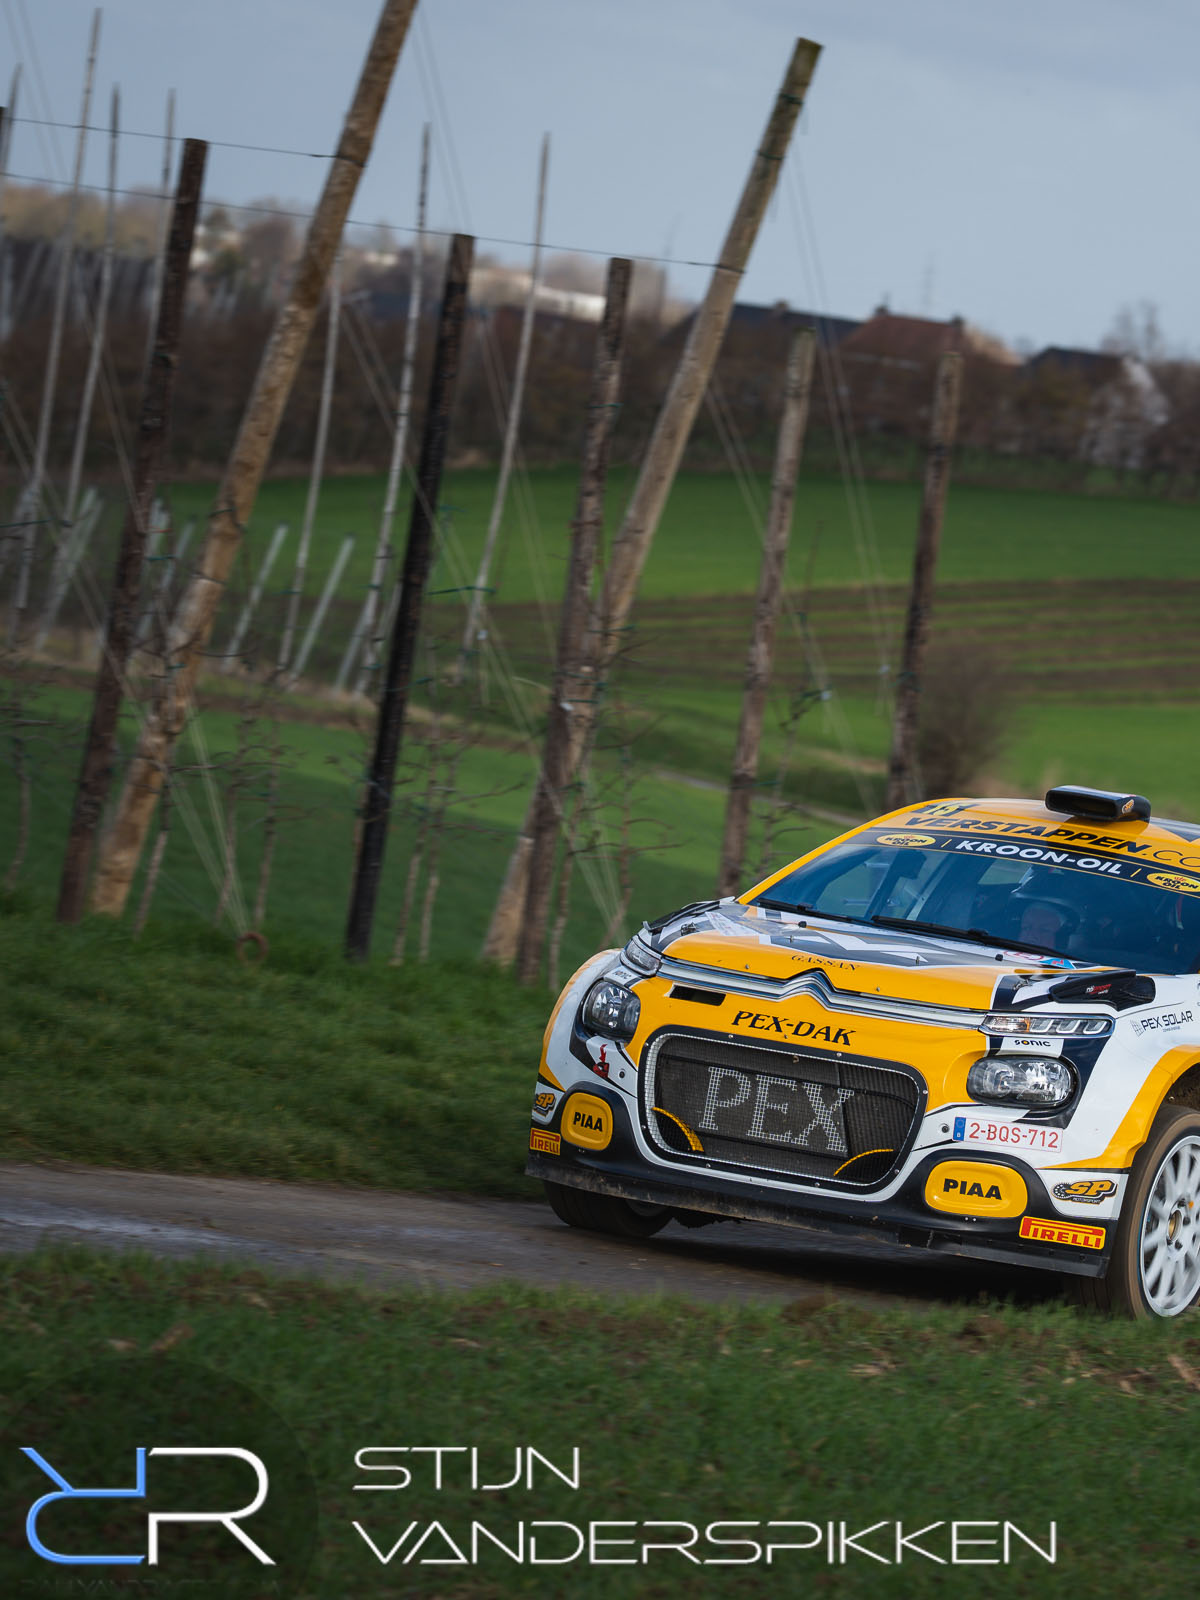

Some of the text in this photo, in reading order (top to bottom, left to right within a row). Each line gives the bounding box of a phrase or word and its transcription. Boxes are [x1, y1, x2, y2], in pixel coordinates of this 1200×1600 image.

[955, 840, 1122, 875] KROON-OIL
[731, 1011, 856, 1046] PEX-DAK
[1140, 1010, 1194, 1031] PEX SOLAR
[573, 1111, 603, 1132] PIAA
[699, 1066, 854, 1153] PEX
[531, 1129, 561, 1155] PIRELLI
[969, 1123, 1059, 1148] 2-BQS-712
[943, 1178, 1002, 1200] PIAA
[1065, 1180, 1112, 1196] SP
[1021, 1217, 1104, 1248] PIRELLI
